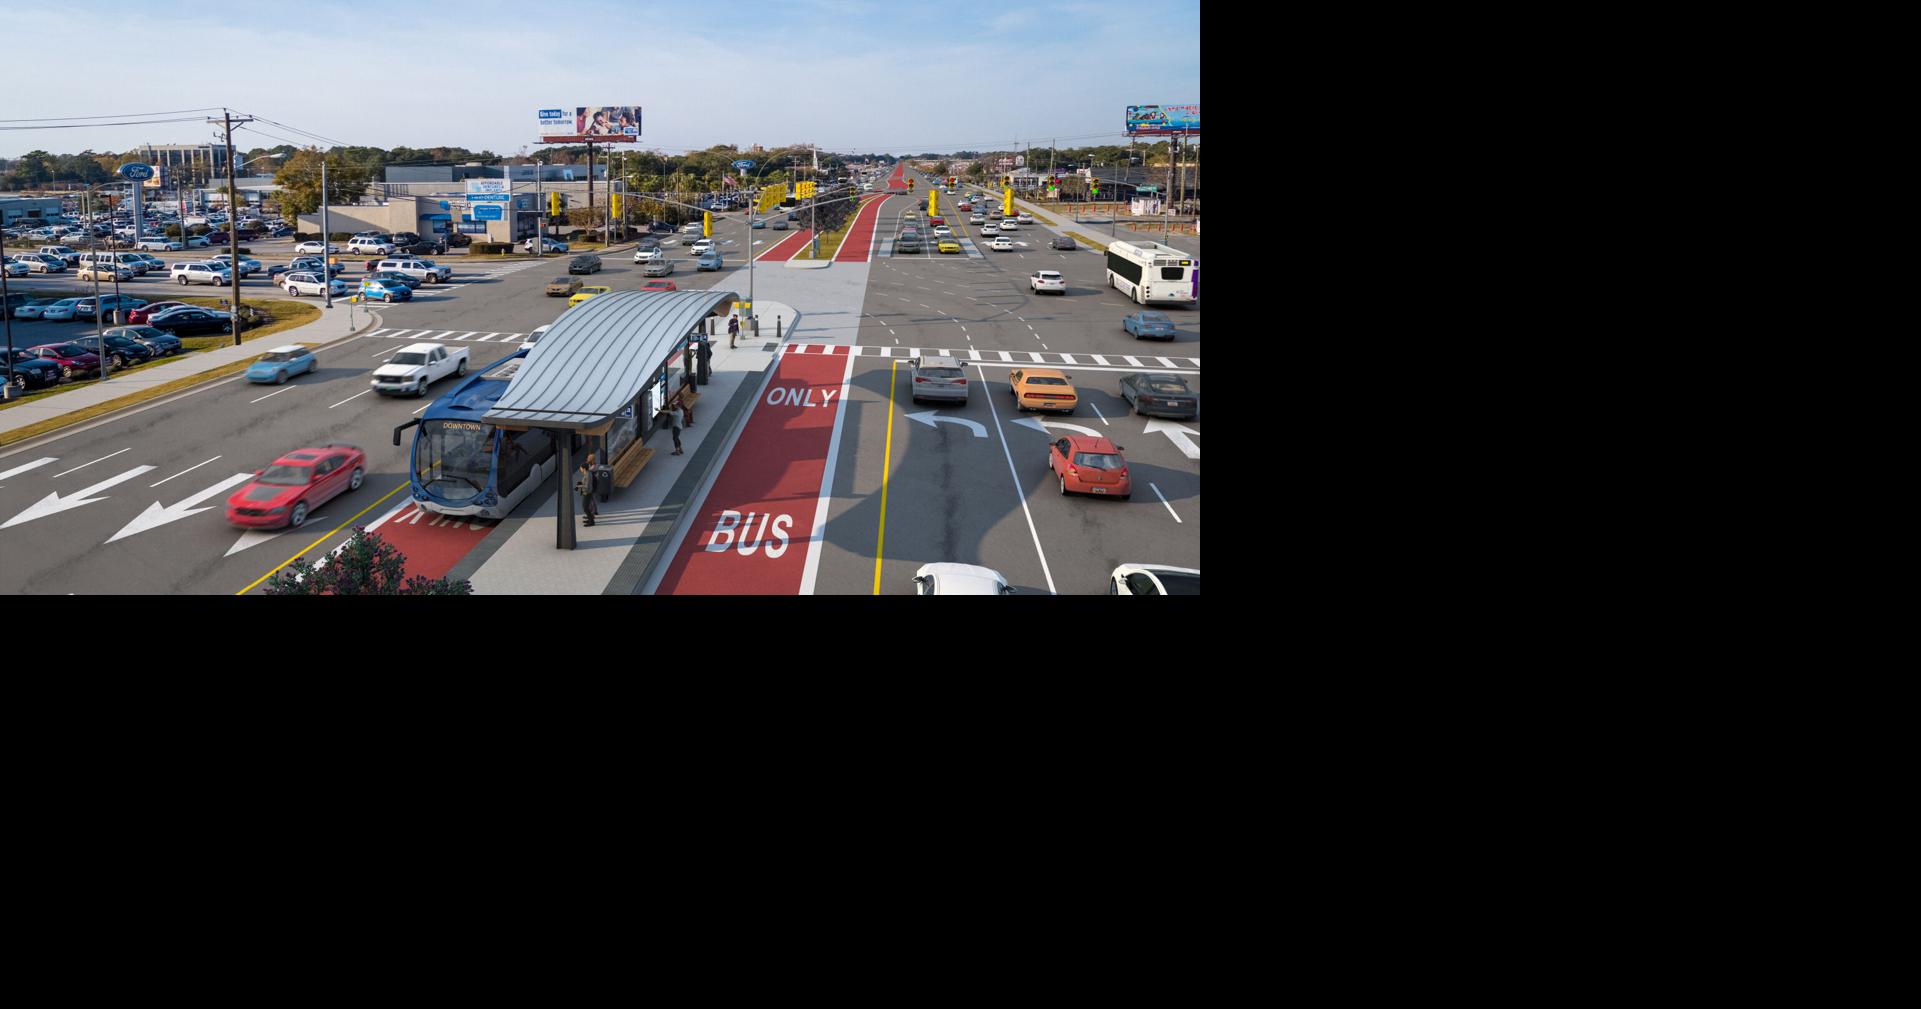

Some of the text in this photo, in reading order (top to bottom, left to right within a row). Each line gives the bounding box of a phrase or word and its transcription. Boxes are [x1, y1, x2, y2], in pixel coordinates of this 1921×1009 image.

[130, 166, 149, 178] Ford
[766, 387, 837, 408] ONLY
[443, 422, 481, 431] DOWNTOWN
[705, 509, 793, 559] BUS
